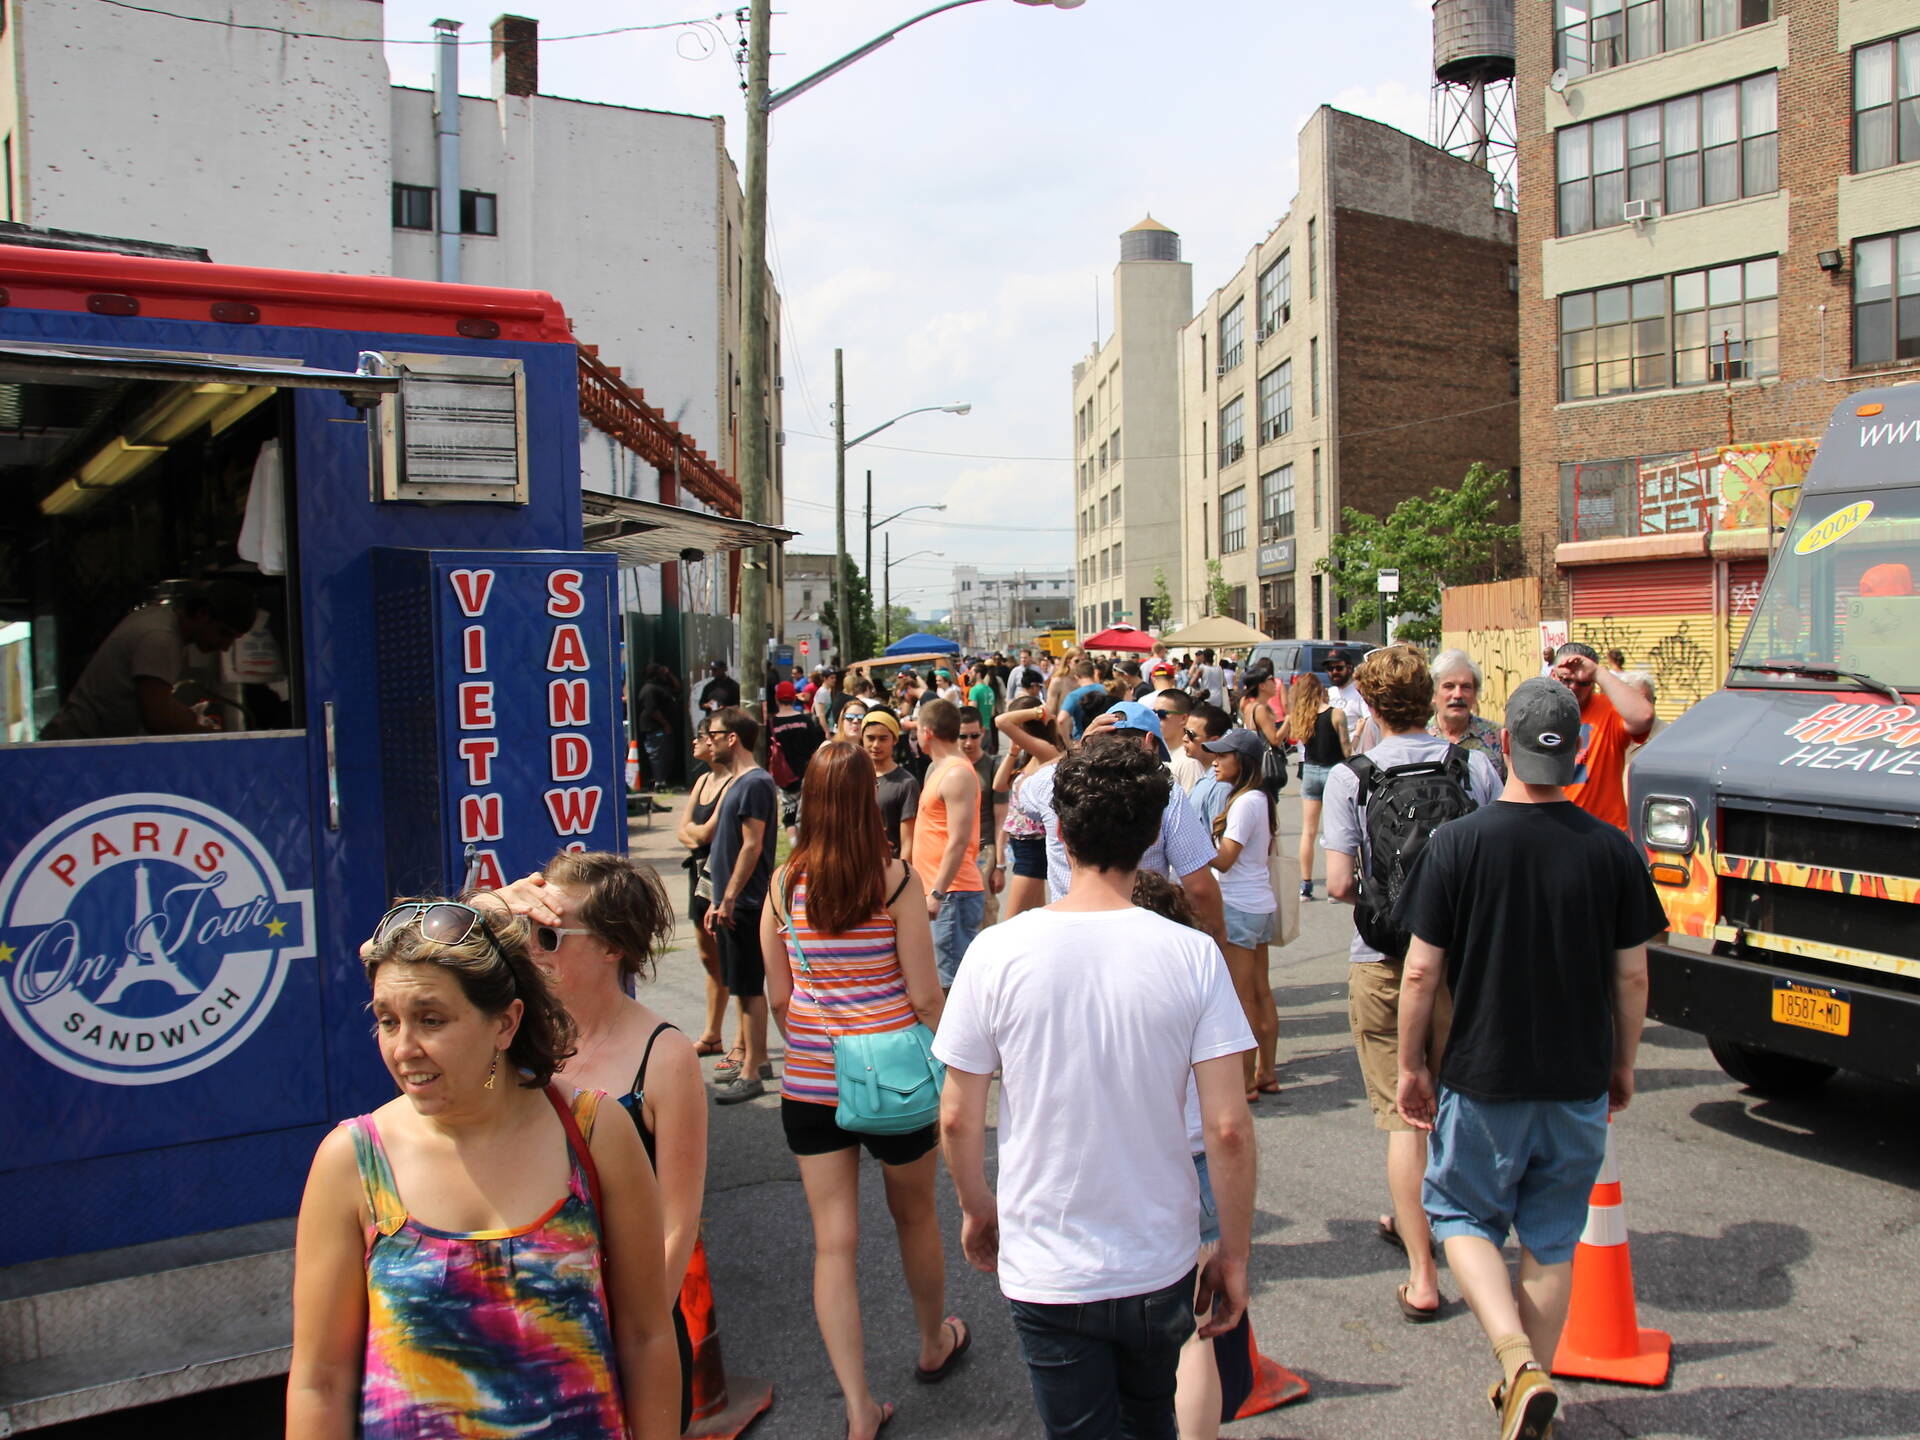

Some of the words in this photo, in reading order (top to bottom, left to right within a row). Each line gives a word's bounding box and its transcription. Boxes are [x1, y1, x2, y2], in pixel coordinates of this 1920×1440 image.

[1860, 420, 1920, 448] WW
[1809, 506, 1859, 549] 2004
[544, 568, 603, 853] SANDW
[1779, 745, 1920, 776] HEAVE
[48, 821, 225, 887] PARIS
[12, 919, 117, 1004] On
[125, 870, 274, 961] Tour
[63, 987, 241, 1053] SANDWICH
